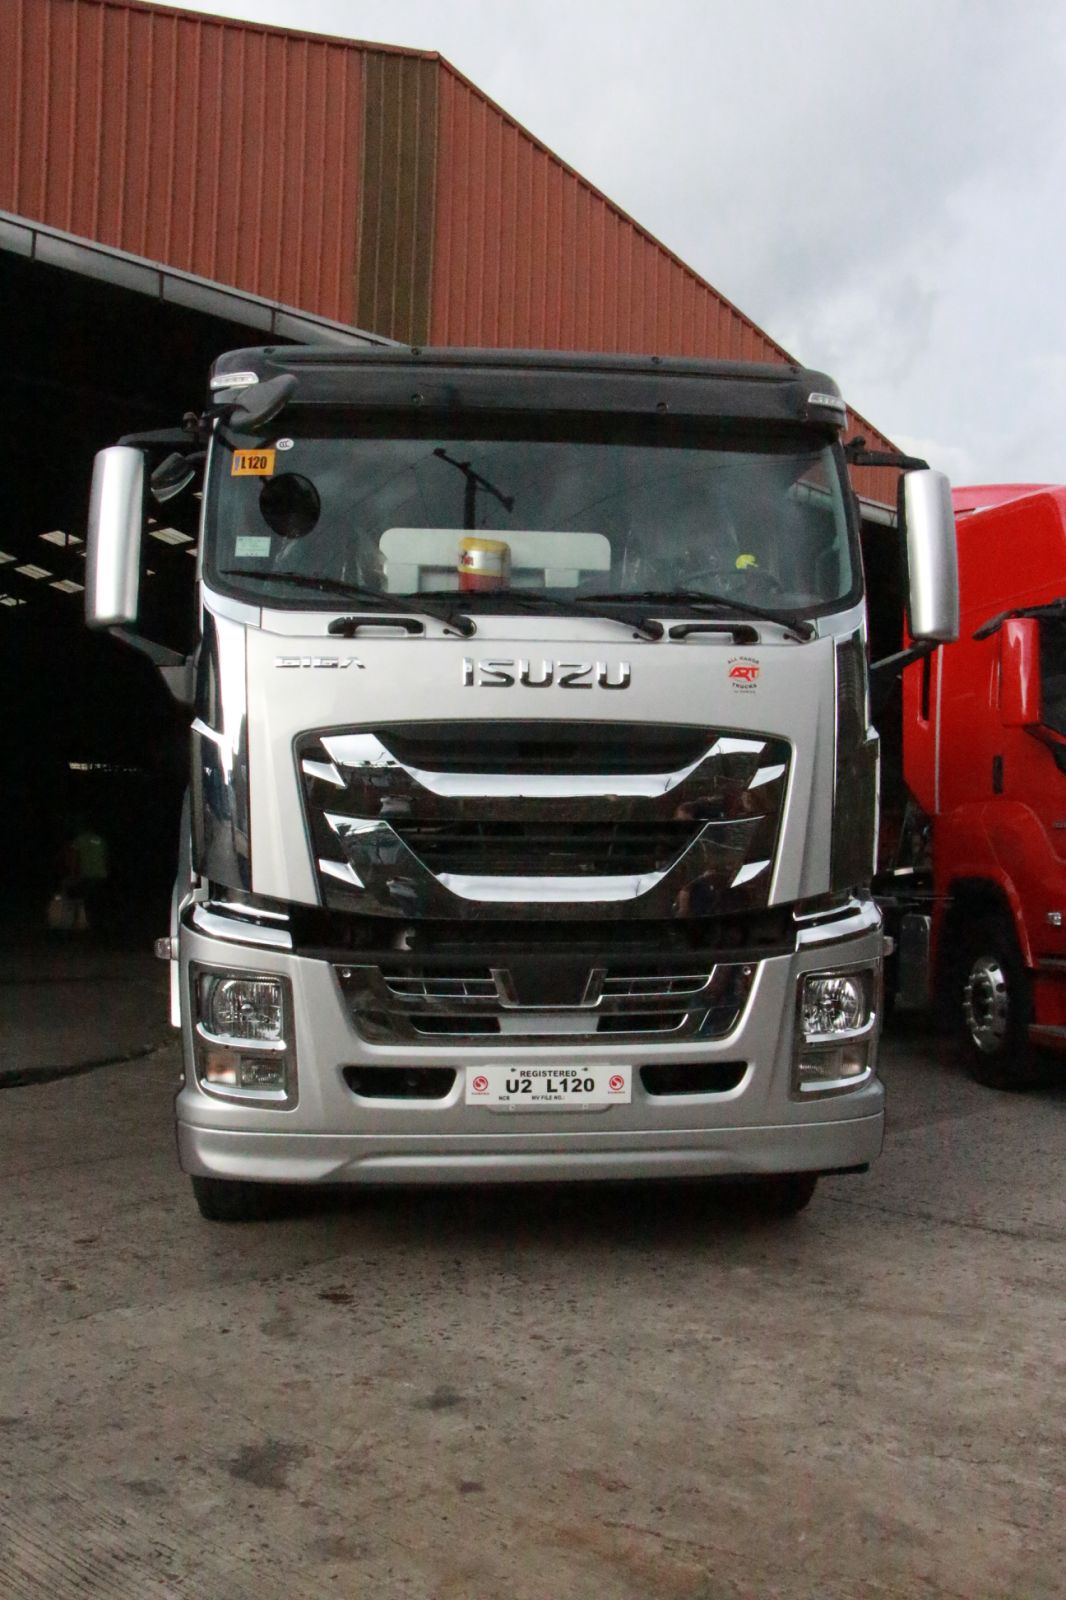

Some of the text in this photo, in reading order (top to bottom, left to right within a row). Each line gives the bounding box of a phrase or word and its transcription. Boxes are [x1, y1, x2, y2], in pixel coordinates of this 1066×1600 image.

[241, 456, 267, 469] L120
[275, 656, 366, 669] GIGA
[463, 657, 631, 690] ISUZU
[729, 666, 760, 682] ART
[520, 1070, 577, 1078] REGISTERED
[506, 1078, 595, 1093] U2 L120
